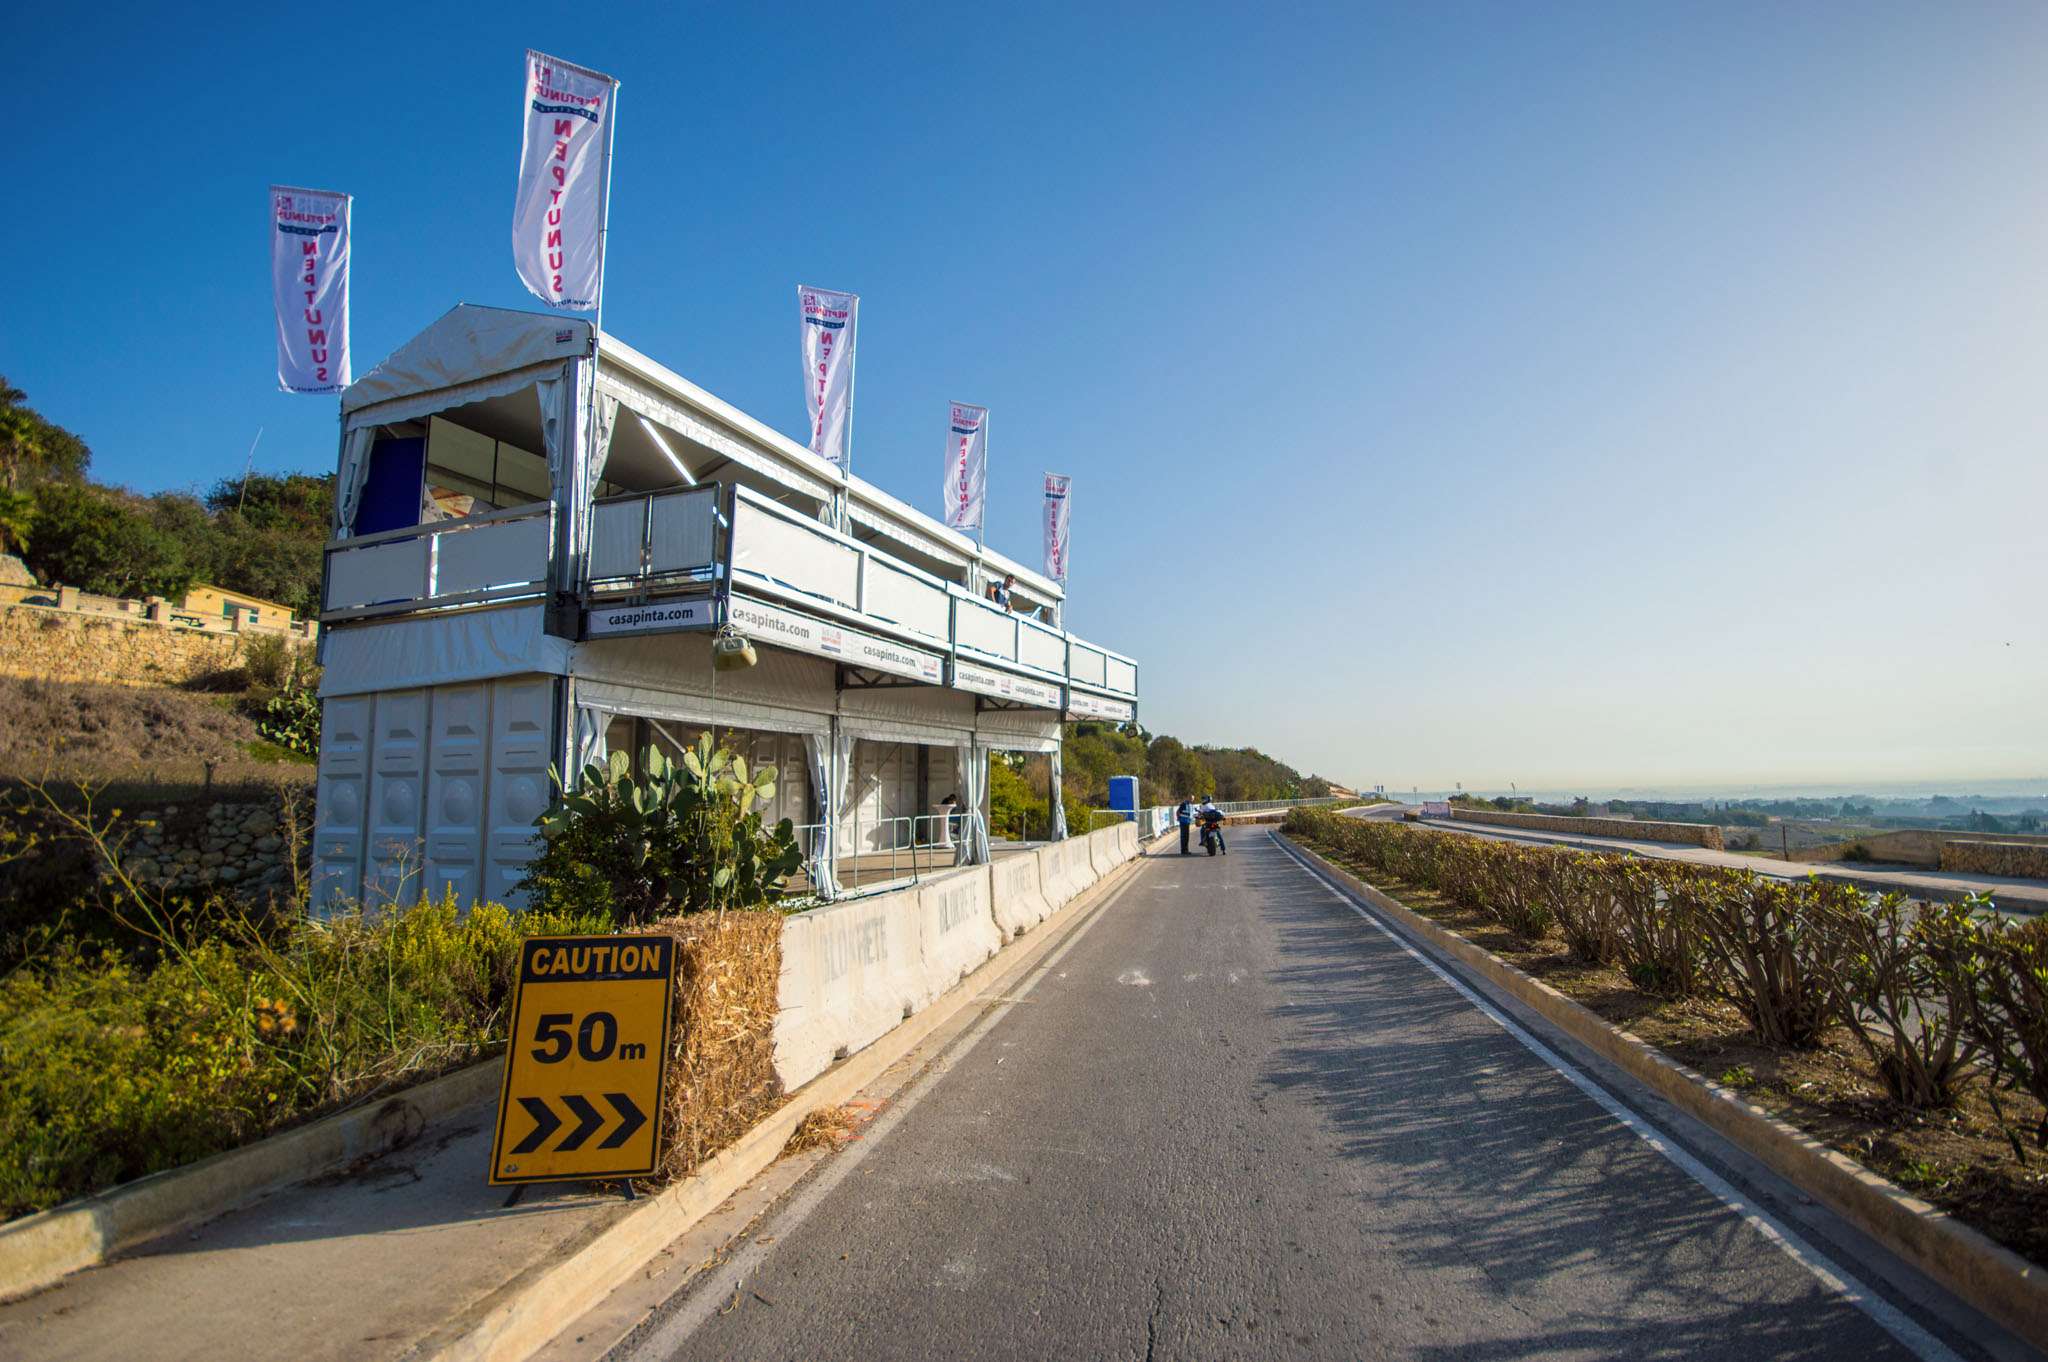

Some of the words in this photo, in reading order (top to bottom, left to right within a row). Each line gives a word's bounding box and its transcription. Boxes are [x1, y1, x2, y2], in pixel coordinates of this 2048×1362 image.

[608, 607, 694, 627] casapinta.com
[732, 607, 810, 639] casapinta.com
[863, 645, 916, 667] casapinta.com
[958, 671, 996, 687] casapinta.com
[530, 944, 661, 976] CAUTION
